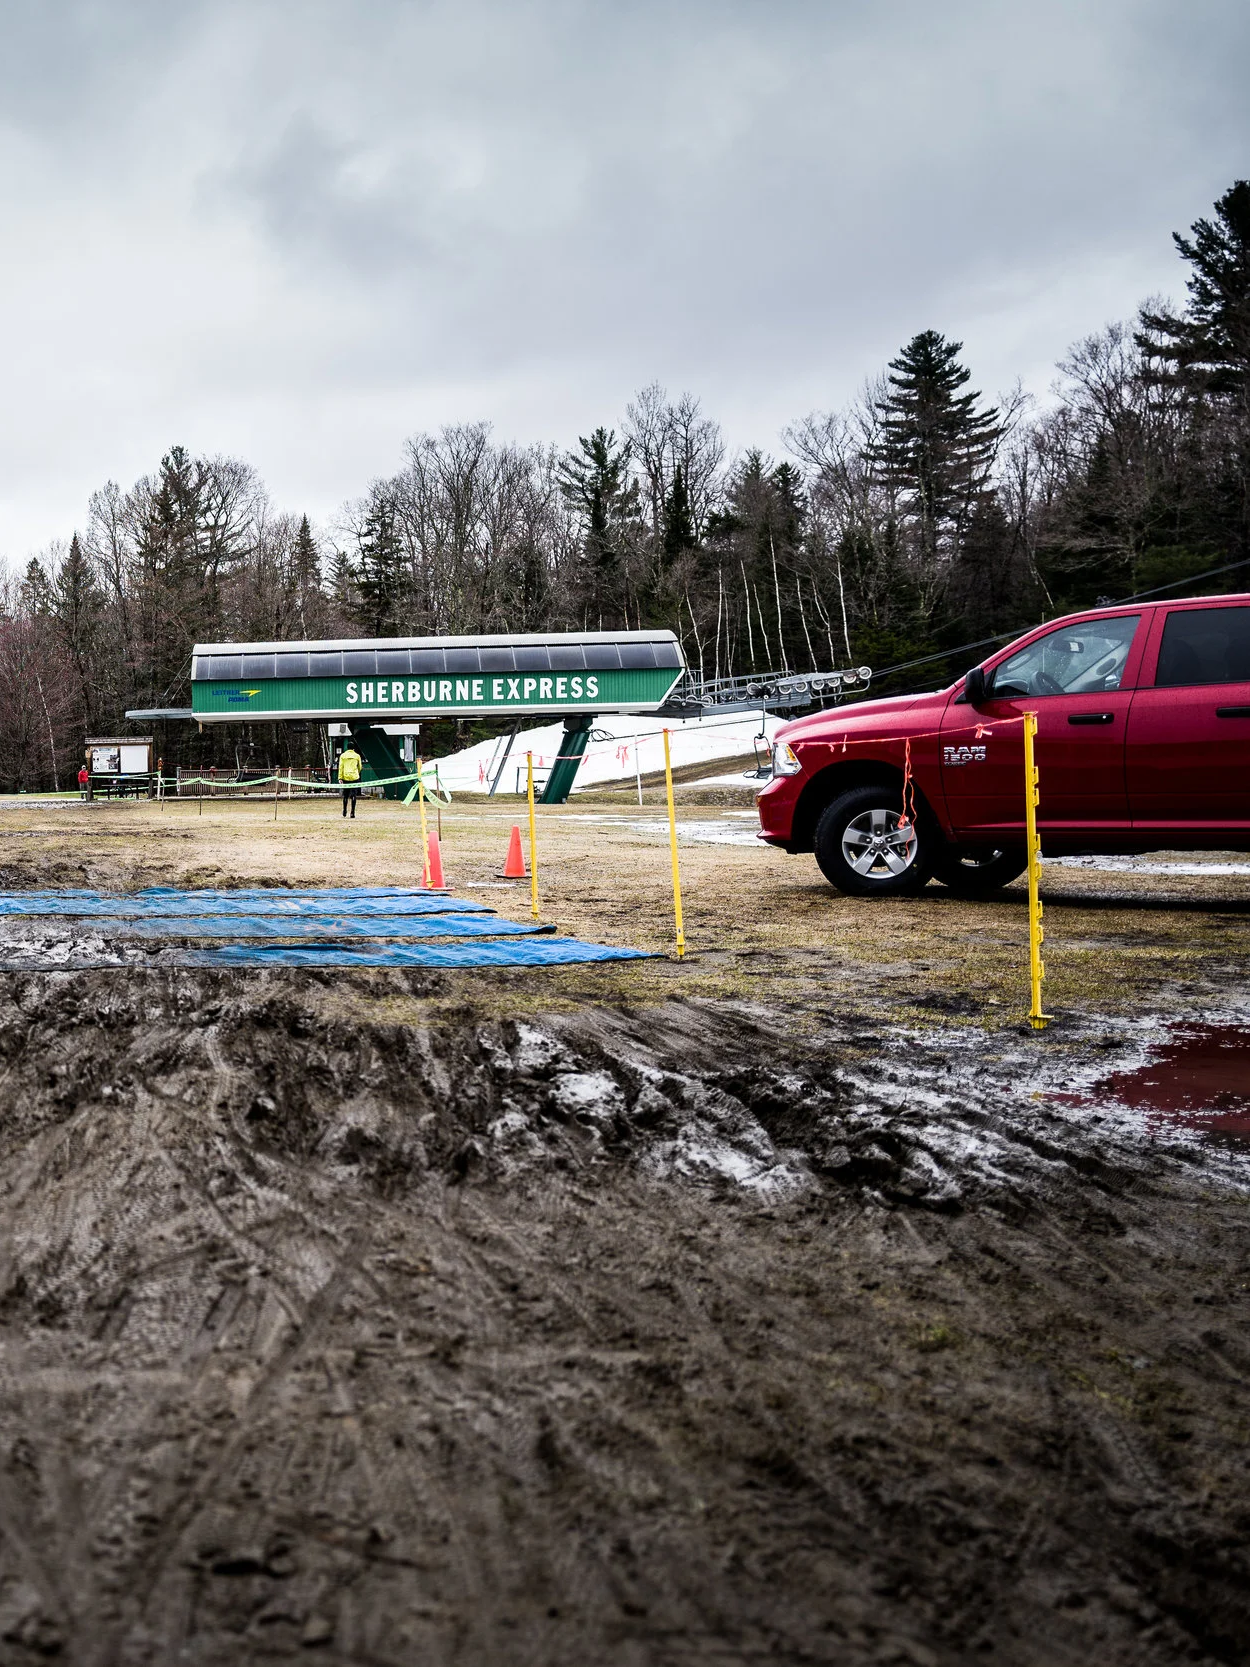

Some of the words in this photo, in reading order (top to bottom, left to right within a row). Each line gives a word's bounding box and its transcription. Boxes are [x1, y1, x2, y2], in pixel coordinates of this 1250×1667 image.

[346, 680, 484, 704] SHERBURNE
[492, 676, 599, 700] EXPRESS
[943, 746, 987, 754] RAM
[943, 753, 987, 761] 1500
